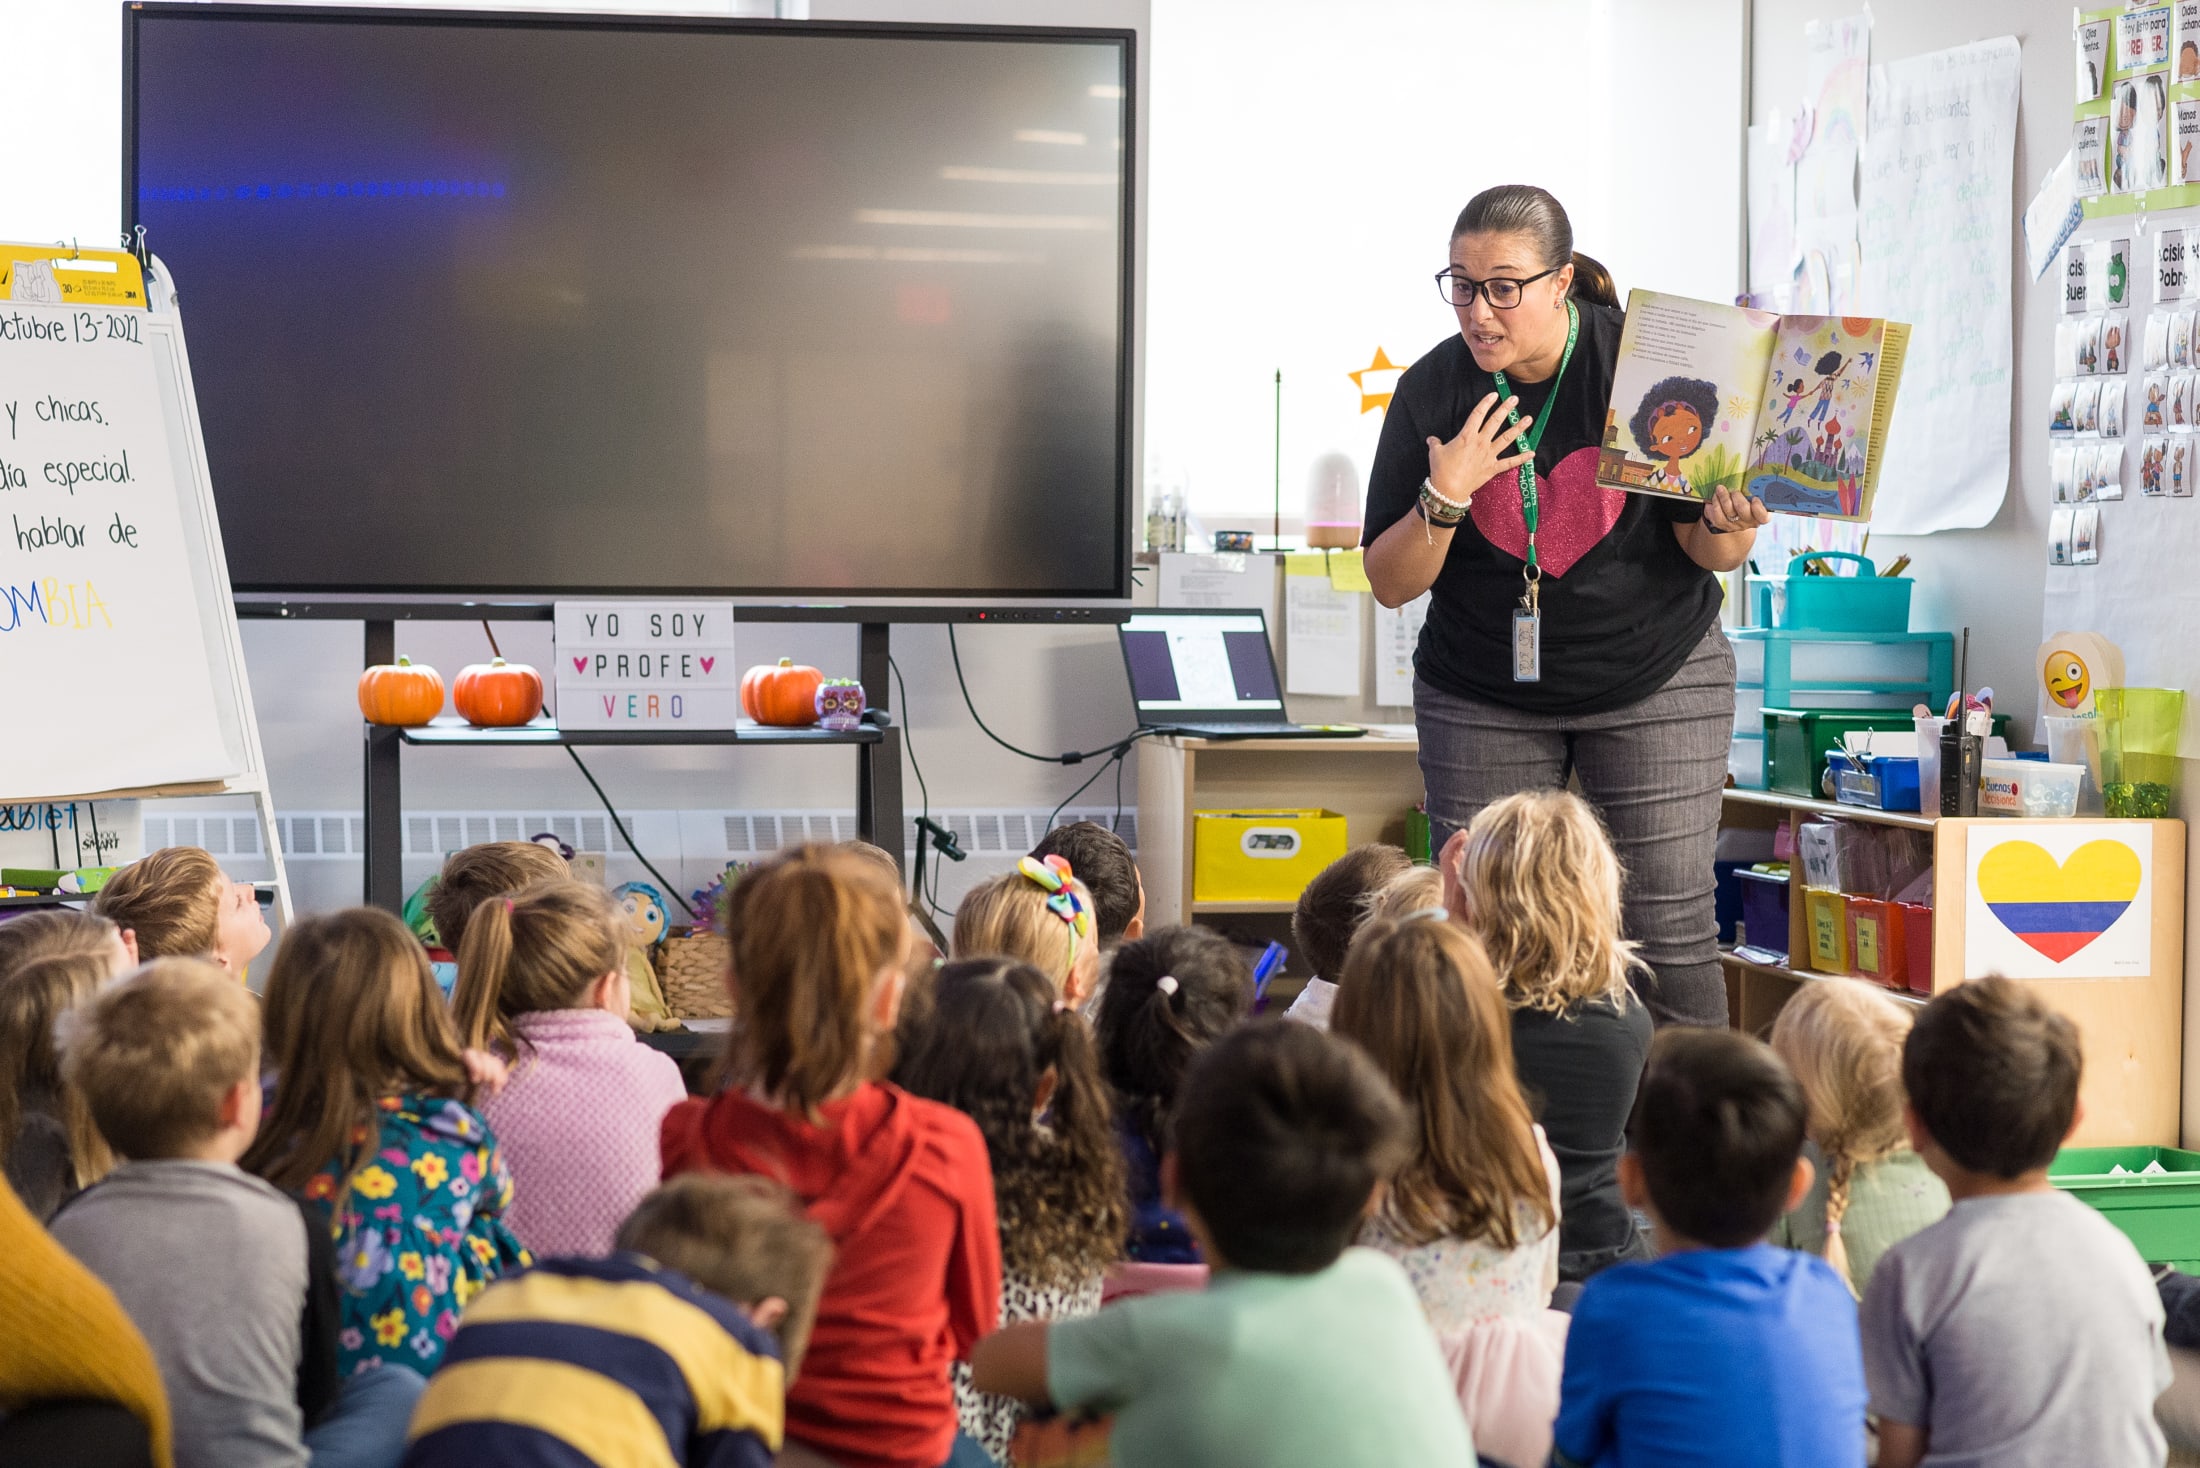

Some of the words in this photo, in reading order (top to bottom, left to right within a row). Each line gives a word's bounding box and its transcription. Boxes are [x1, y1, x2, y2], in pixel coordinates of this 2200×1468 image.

[2150, 18, 2166, 31] para
[62, 283, 73, 293] 30
[125, 290, 137, 299] 3M
[0, 311, 67, 342] ctubre
[5, 400, 17, 440] y
[35, 394, 109, 427] chicas.
[43, 448, 136, 496] especial.
[12, 513, 86, 553] hablar
[108, 511, 139, 549] de
[585, 613, 619, 637] YO
[650, 613, 705, 637] SOY
[595, 654, 692, 678] PROFE
[603, 694, 683, 719] VERO
